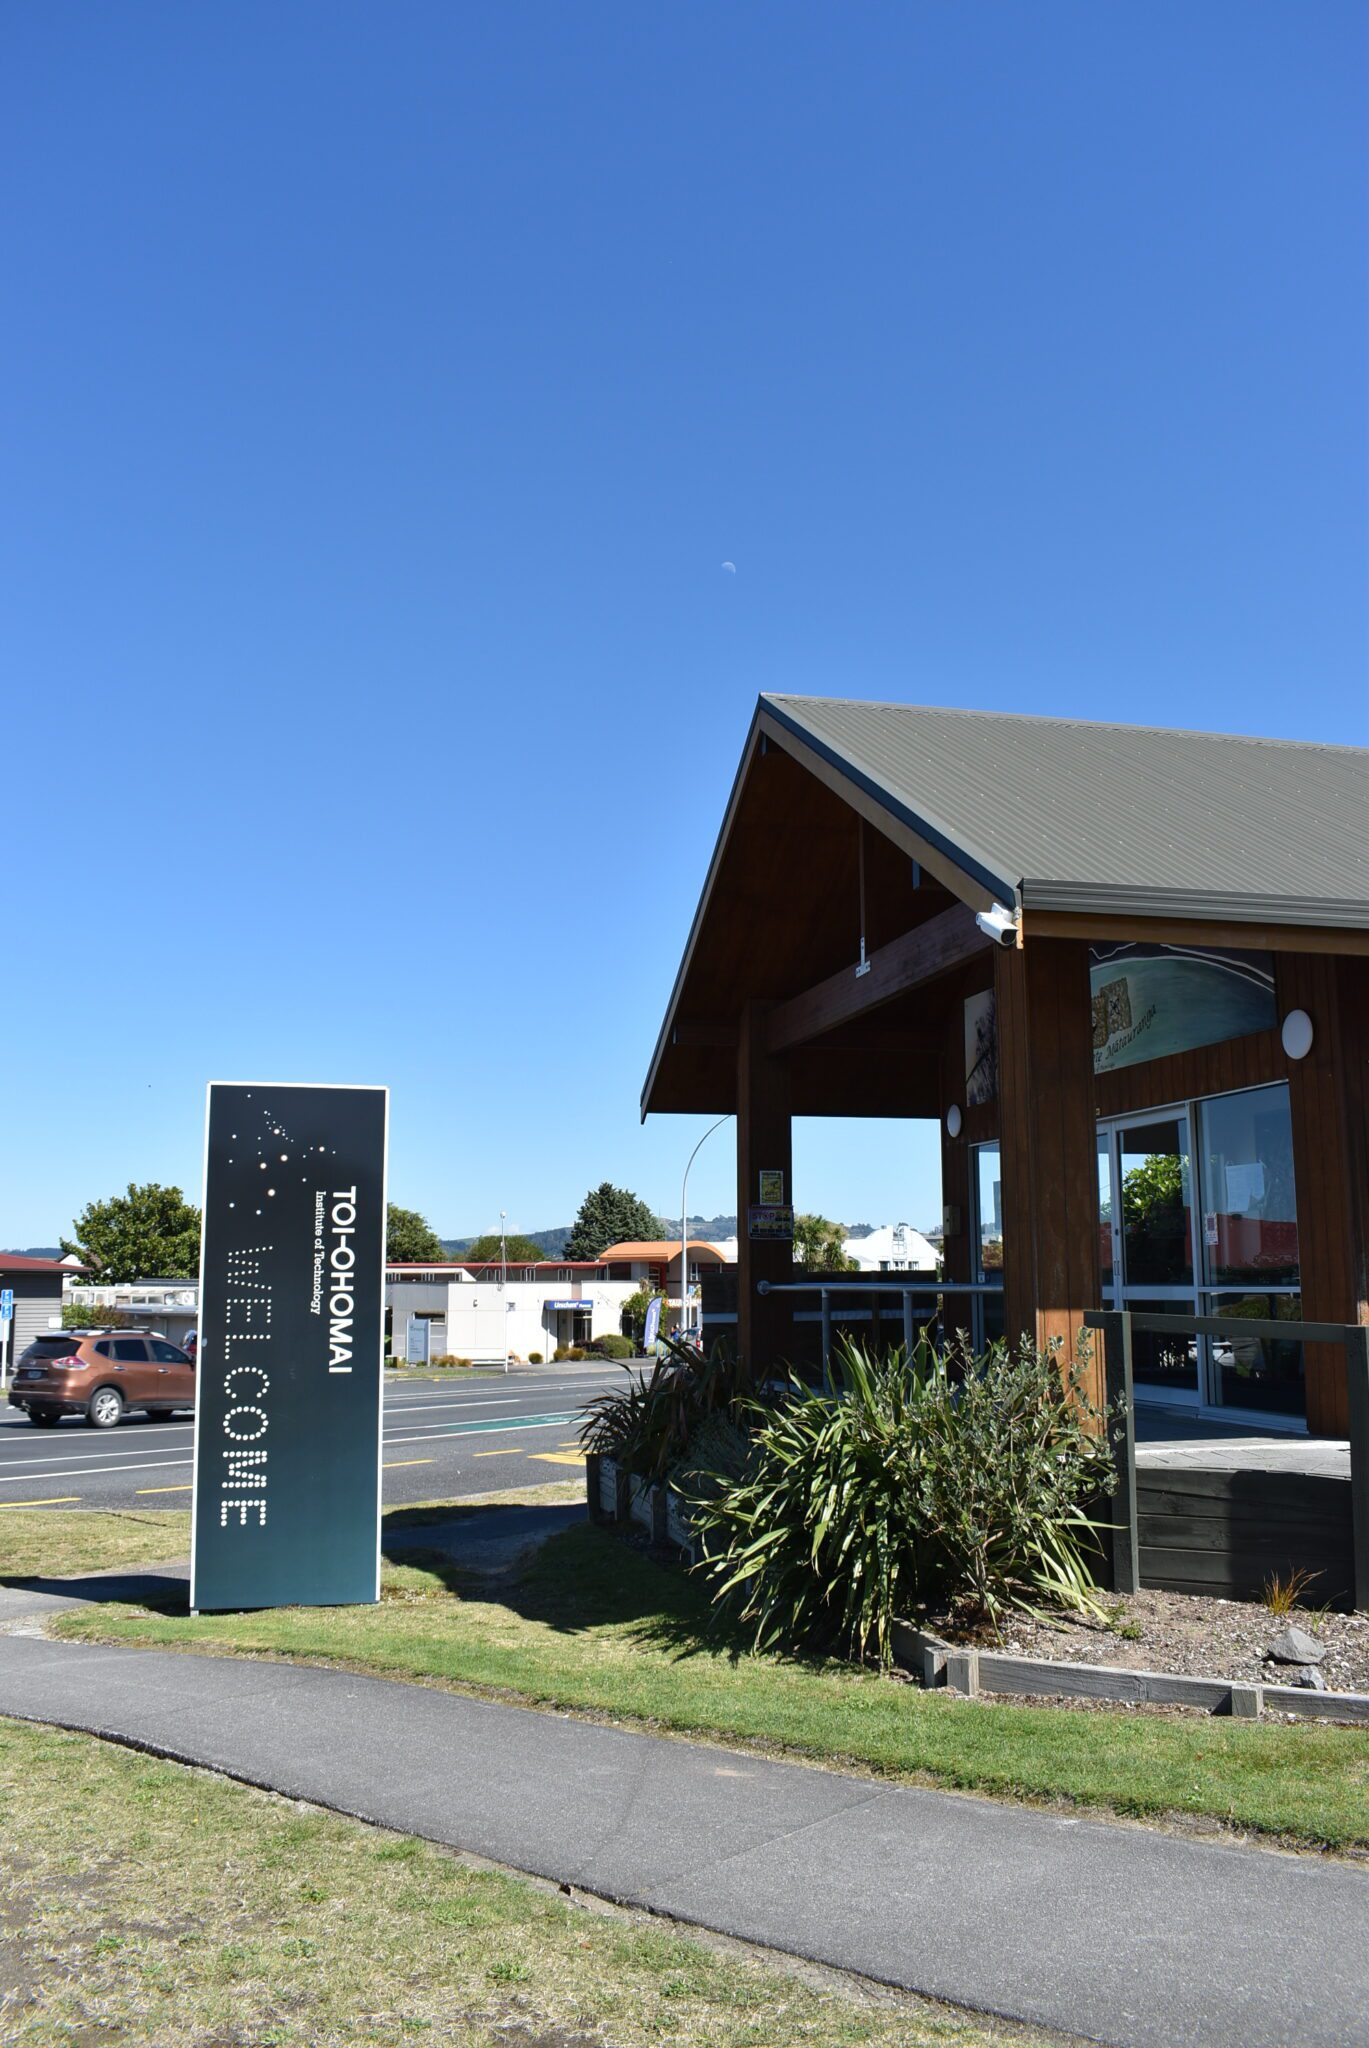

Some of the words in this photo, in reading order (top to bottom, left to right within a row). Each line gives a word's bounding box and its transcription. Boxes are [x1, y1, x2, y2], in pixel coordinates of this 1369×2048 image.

[314, 1190, 326, 1237] Institute
[313, 1238, 325, 1250] of
[310, 1251, 325, 1316] Technology
[220, 1245, 273, 1527] WELCOME
